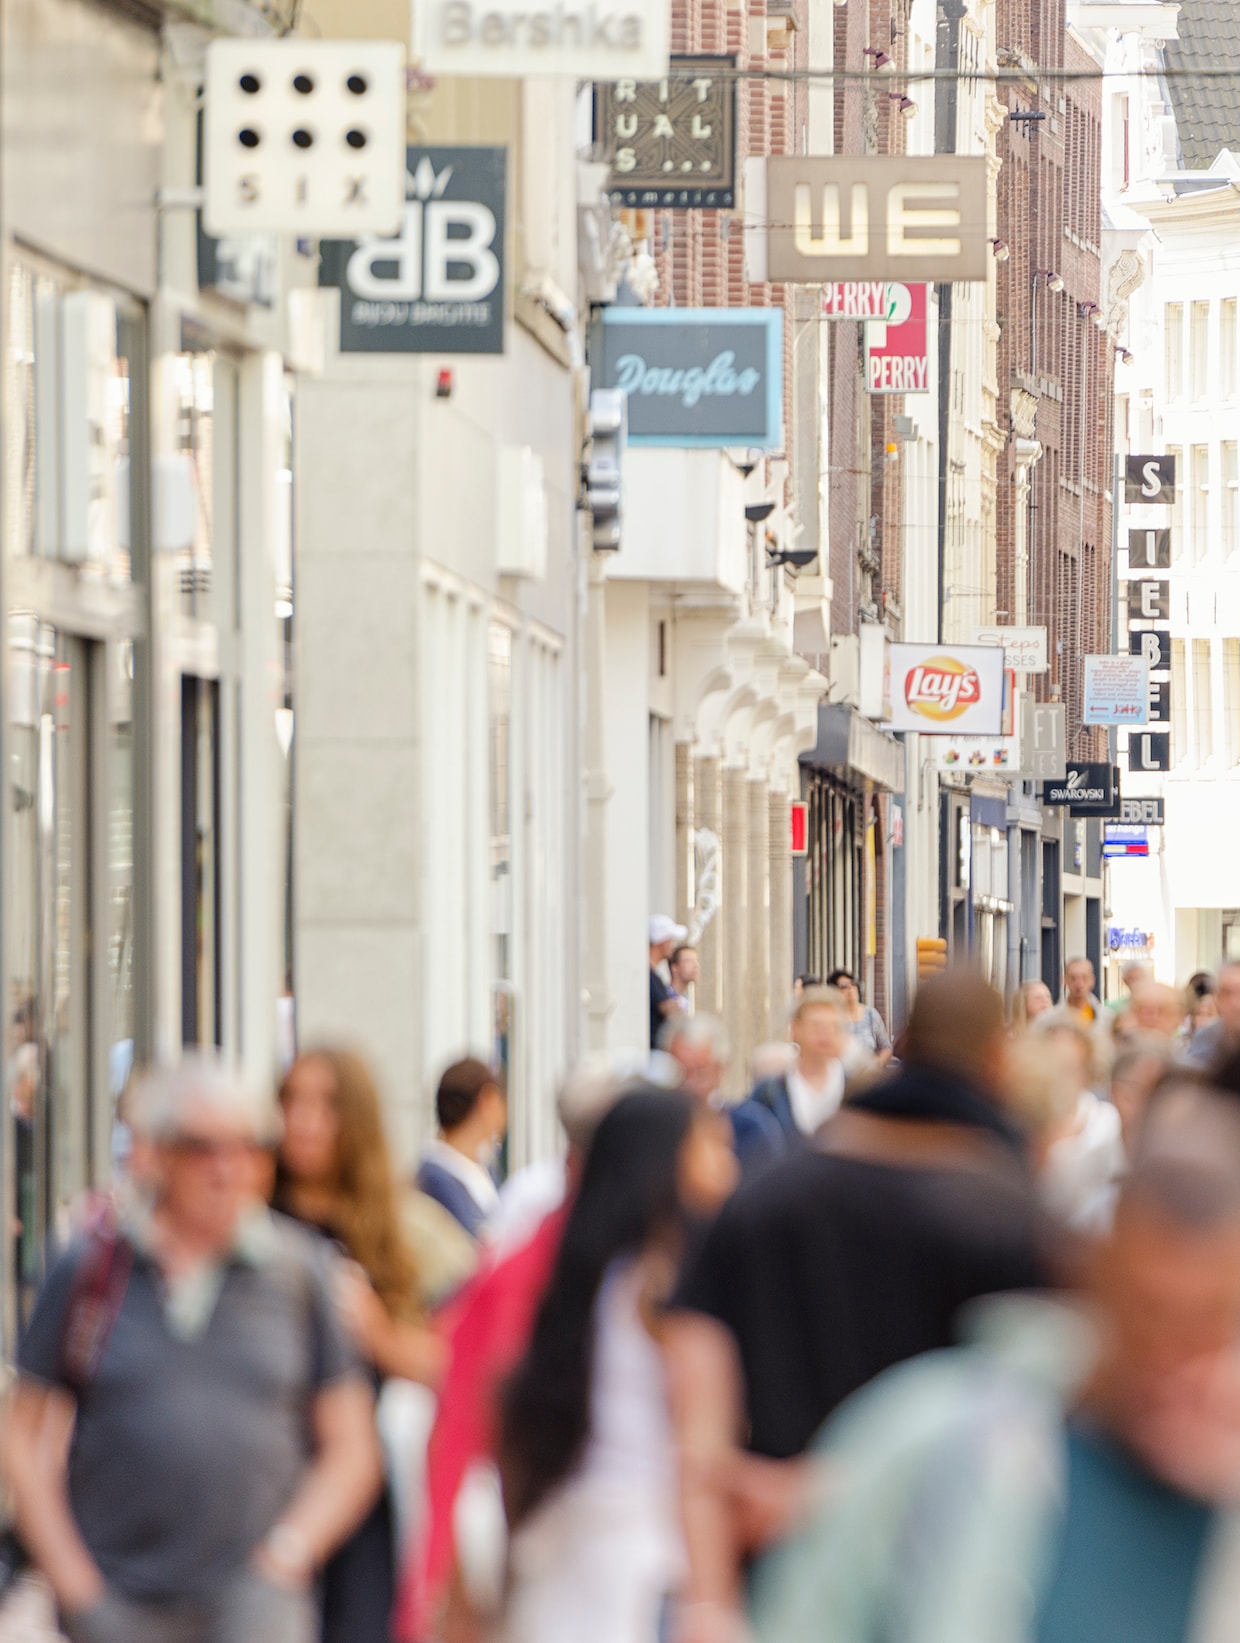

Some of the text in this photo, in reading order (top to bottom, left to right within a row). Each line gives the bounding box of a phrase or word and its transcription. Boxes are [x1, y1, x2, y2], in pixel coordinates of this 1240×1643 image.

[442, 1, 642, 49] Bershka
[237, 172, 367, 206] SIX
[610, 190, 734, 205] osmetics
[794, 181, 962, 256] WE
[821, 281, 885, 317] PERRY
[615, 349, 760, 408] Douglas
[869, 356, 927, 390] PERRY
[978, 633, 1040, 655] Steps
[907, 666, 977, 713] Lay's
[1049, 788, 1105, 801] SWAROVSKI
[1105, 800, 1163, 823] EBEL
